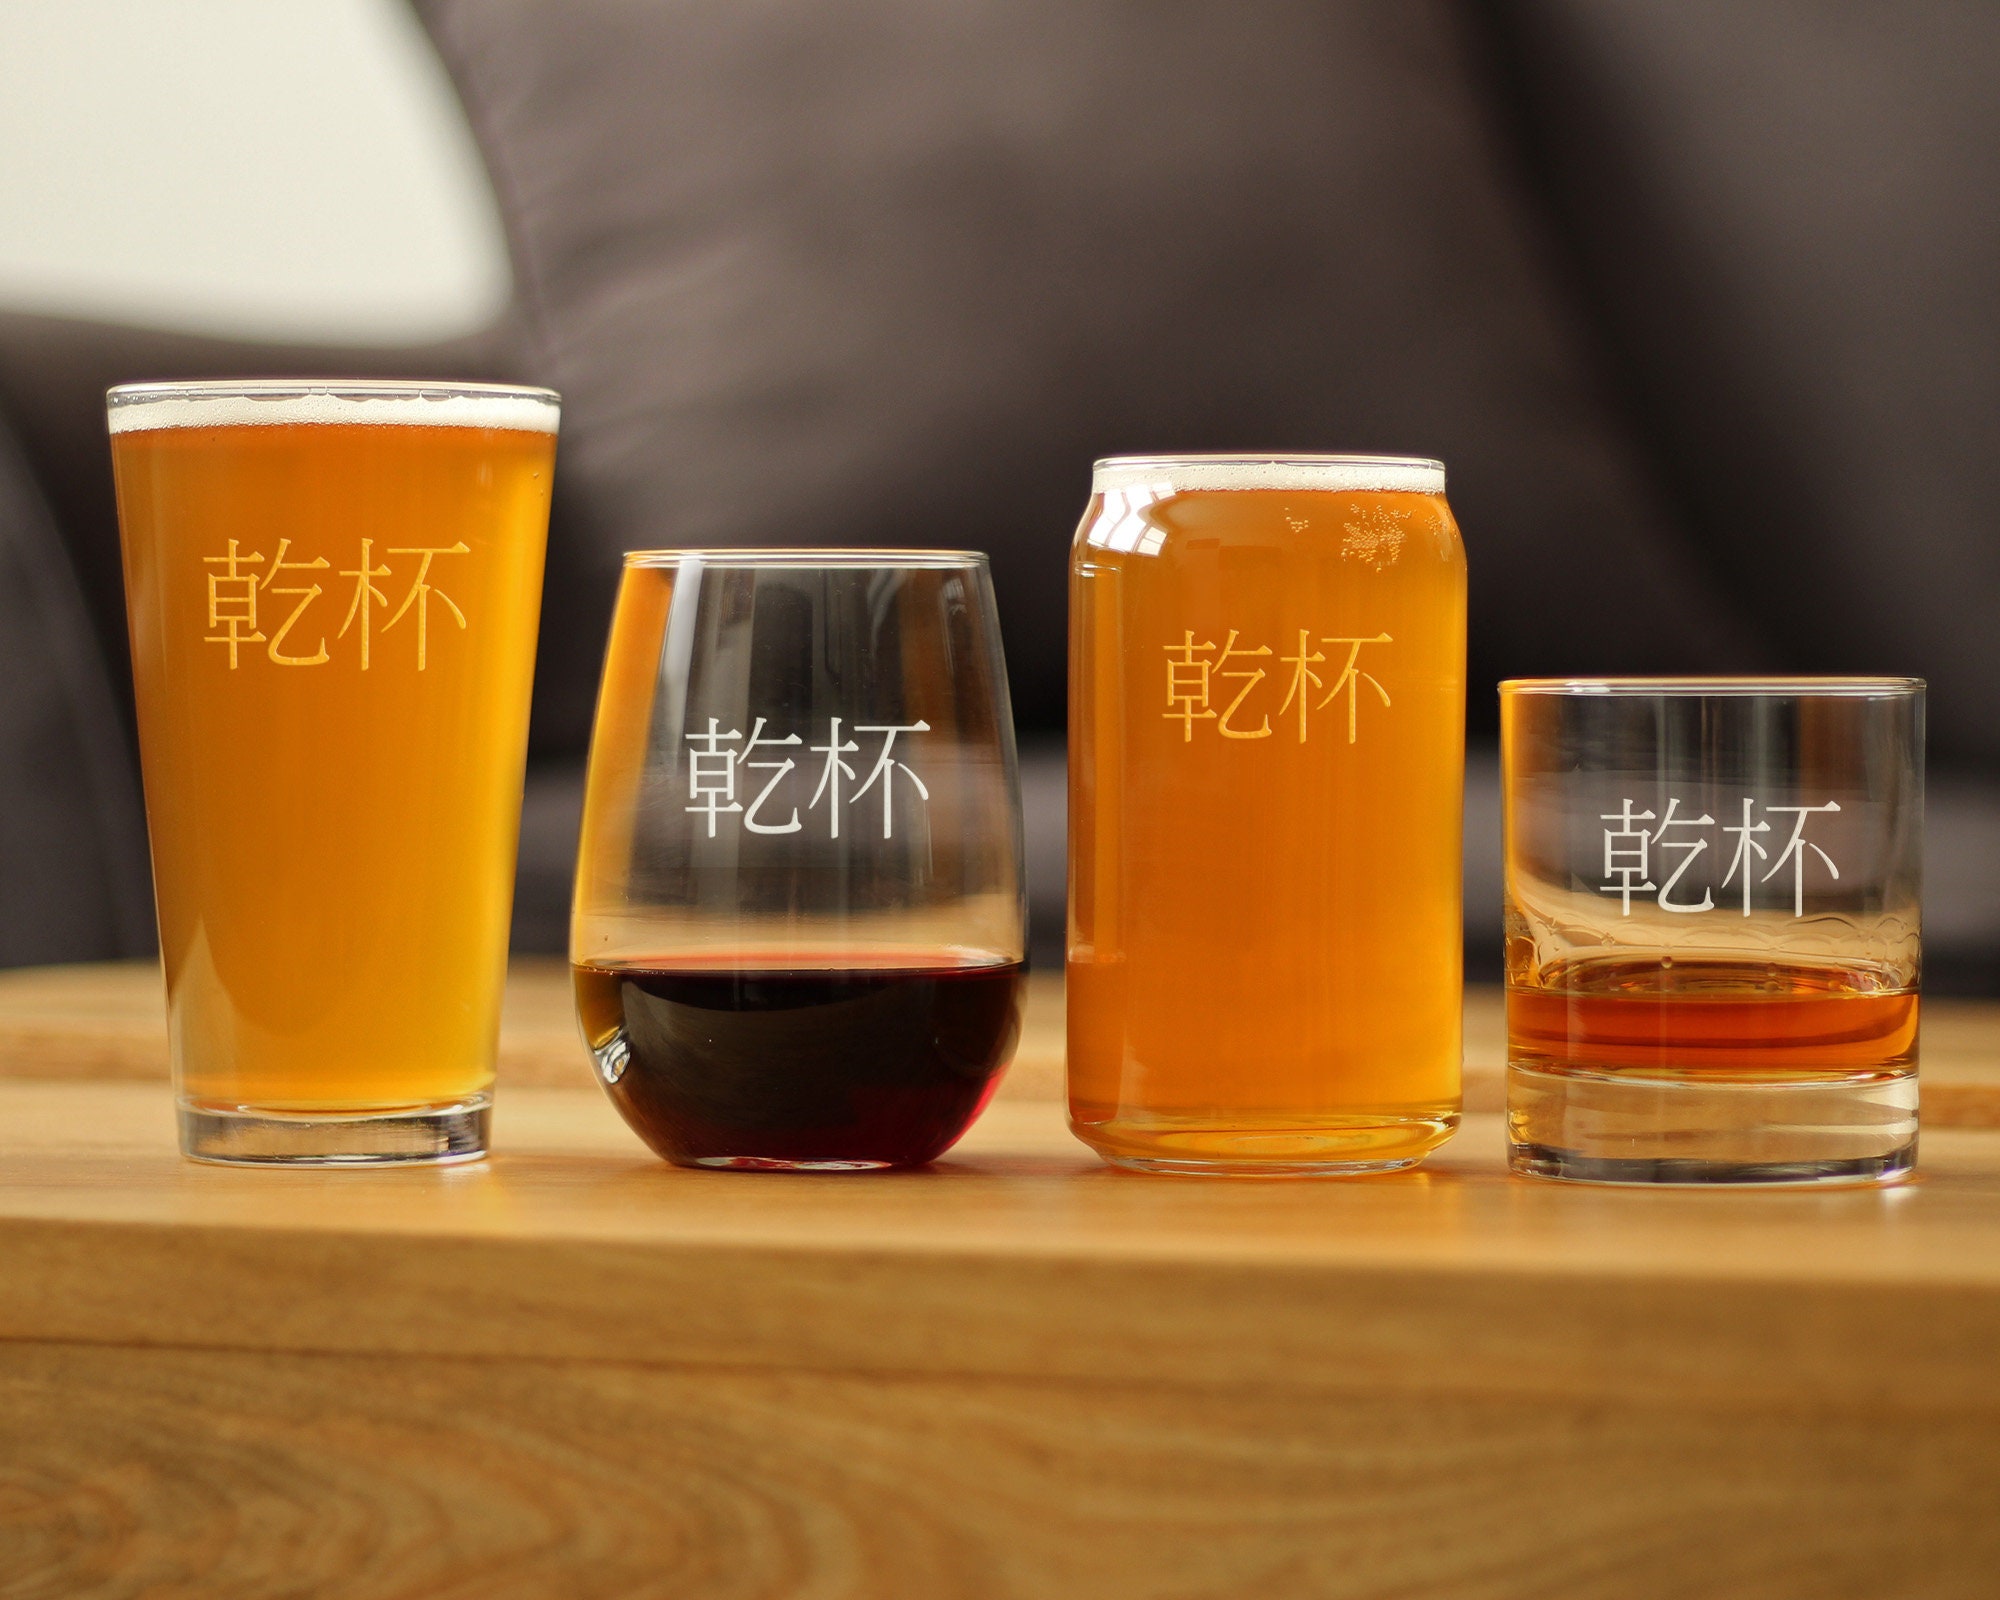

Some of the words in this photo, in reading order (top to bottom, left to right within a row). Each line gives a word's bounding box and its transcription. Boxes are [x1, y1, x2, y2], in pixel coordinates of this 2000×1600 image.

[202, 537, 471, 672] 乾杯
[1162, 629, 1393, 744] 乾杯
[684, 717, 931, 839] 乾杯
[1599, 797, 1841, 918] 乾杯
